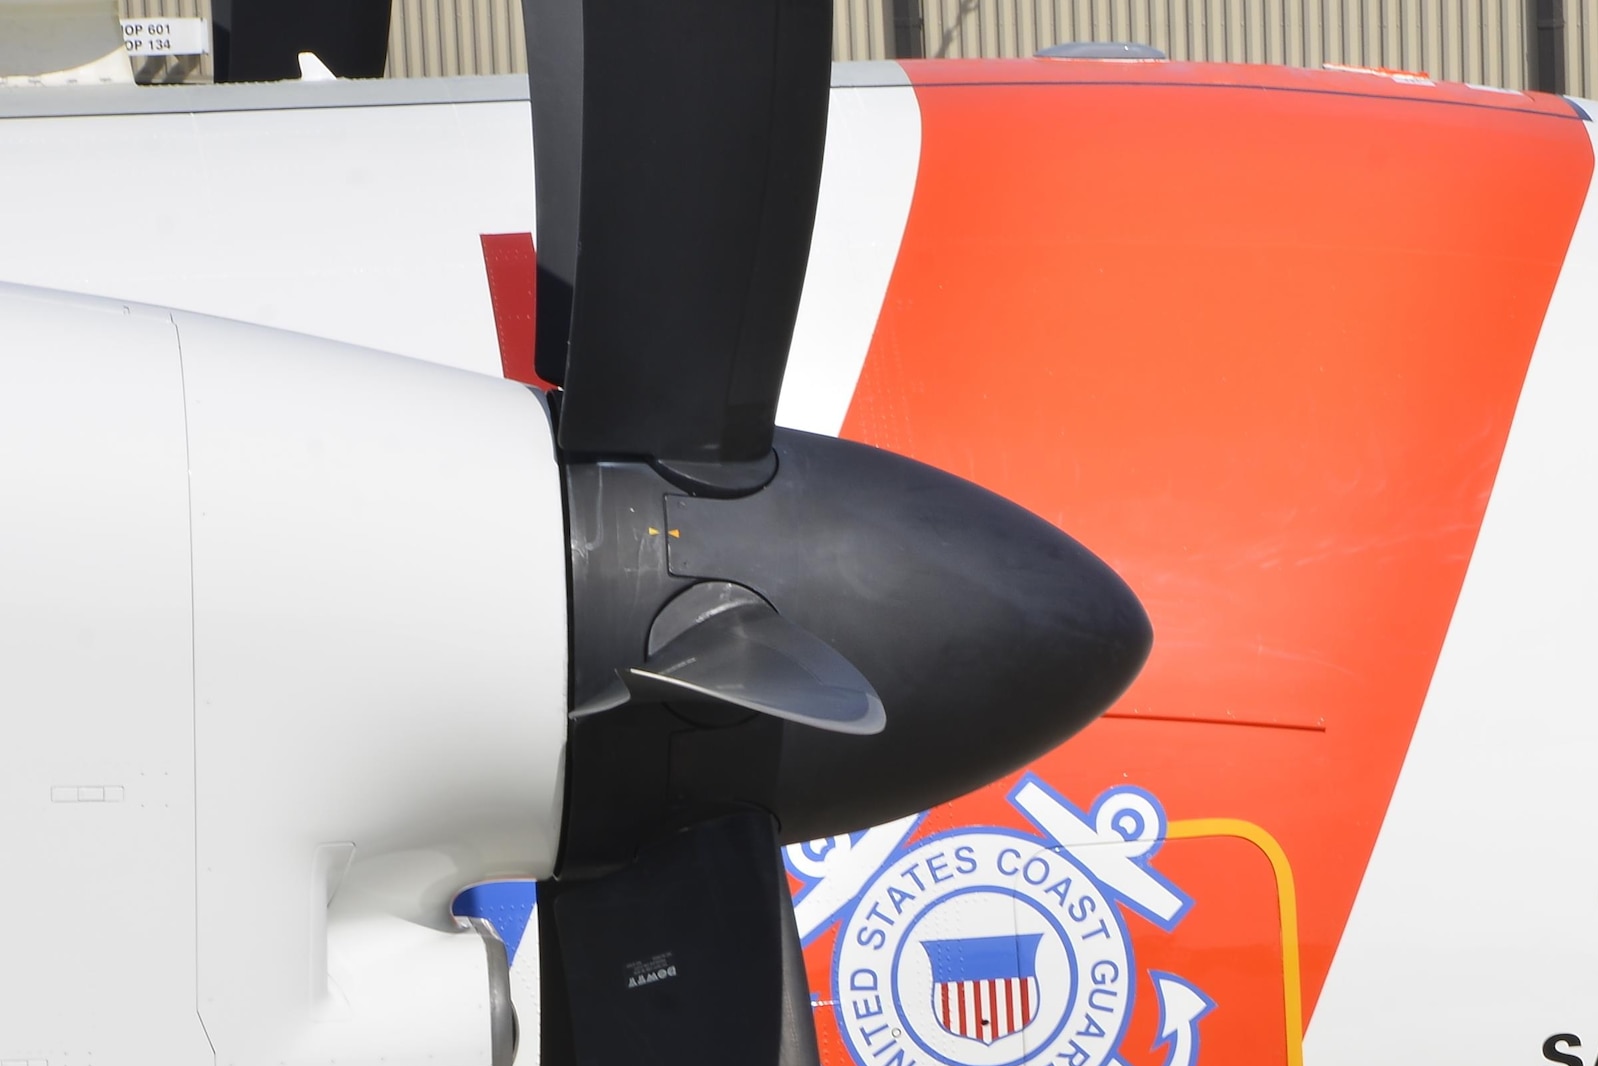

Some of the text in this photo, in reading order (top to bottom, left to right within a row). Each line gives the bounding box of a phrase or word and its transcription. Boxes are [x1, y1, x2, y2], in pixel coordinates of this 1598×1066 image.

[148, 24, 170, 36] 601
[149, 39, 171, 51] 134
[856, 846, 978, 950] STATES
[997, 848, 1111, 941] COAST
